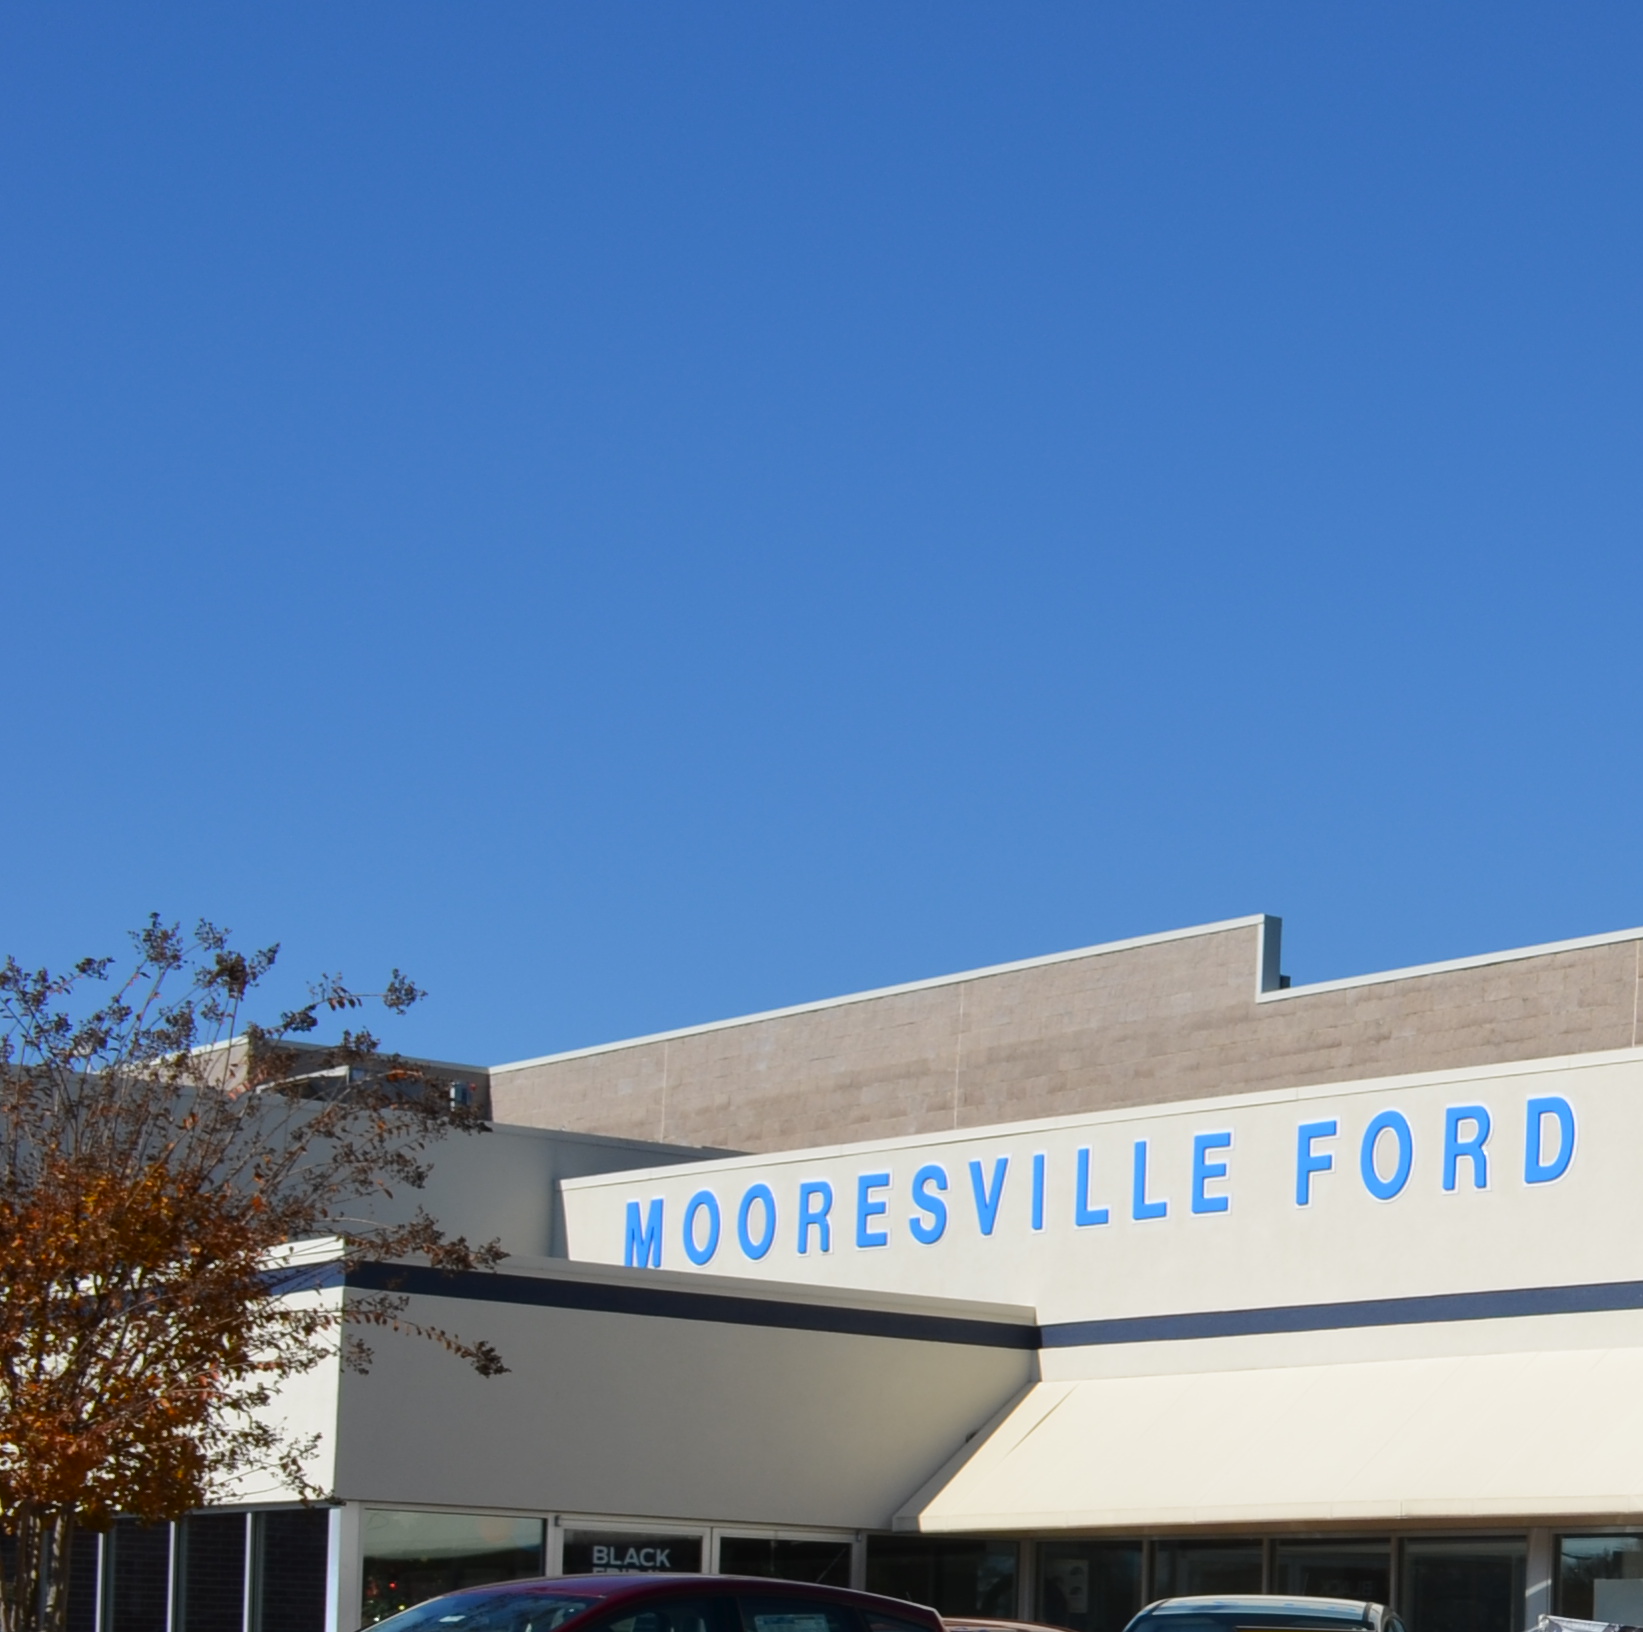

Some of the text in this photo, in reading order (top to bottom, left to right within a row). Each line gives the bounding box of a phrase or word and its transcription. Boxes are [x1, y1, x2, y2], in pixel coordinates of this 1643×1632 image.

[624, 1095, 1578, 1268] MOORESVILLE FORD
[592, 1545, 671, 1567] BLACK
